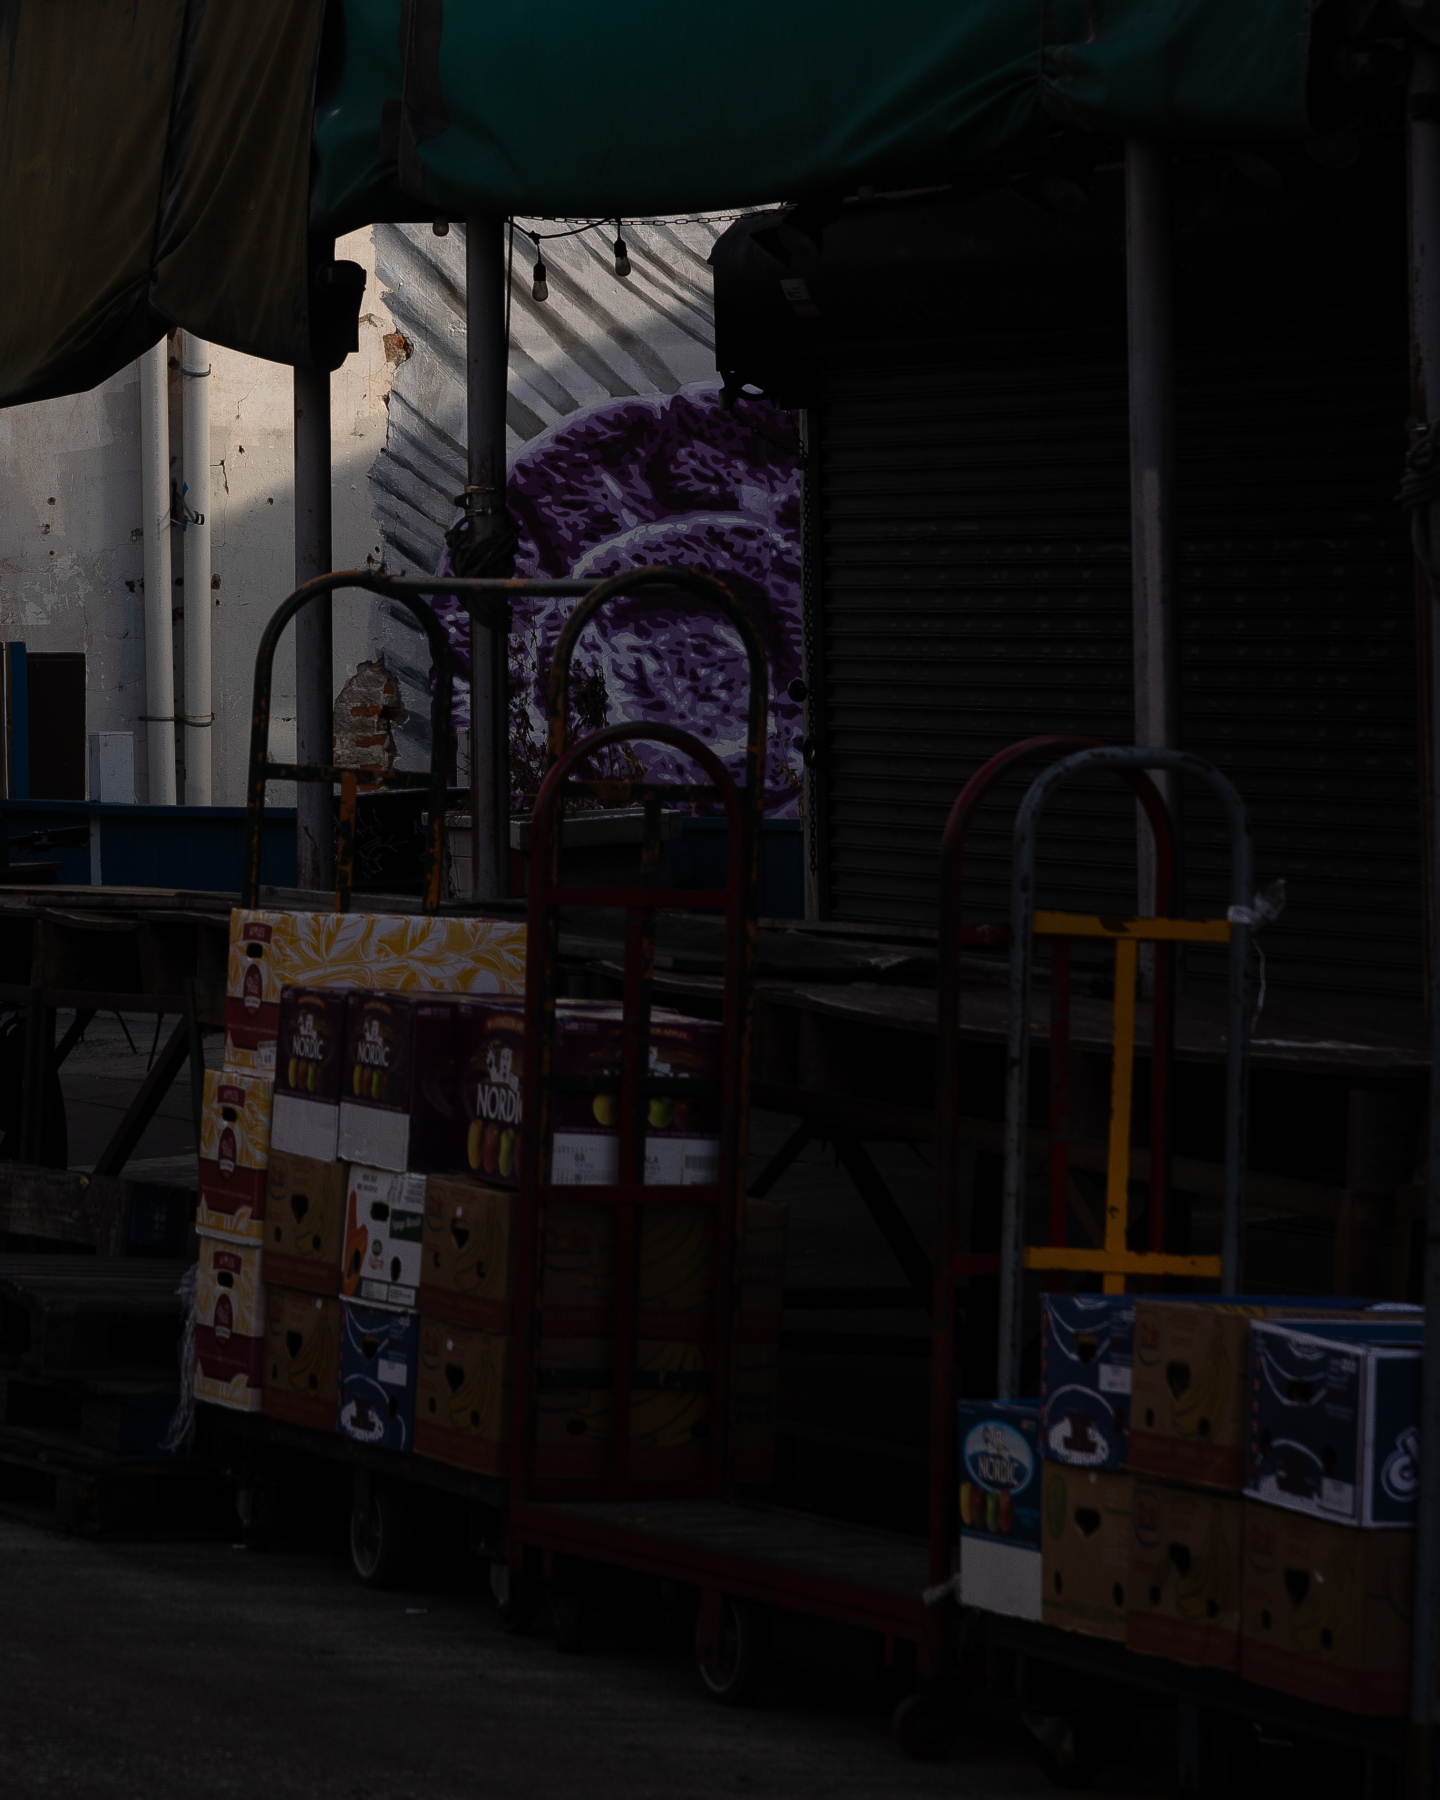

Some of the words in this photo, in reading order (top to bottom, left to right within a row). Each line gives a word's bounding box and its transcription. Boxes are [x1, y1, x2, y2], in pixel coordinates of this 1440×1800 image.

[292, 1036, 324, 1060] NORDIC
[357, 1041, 390, 1067] NORDIC
[476, 1082, 523, 1125] NORDI
[977, 1454, 1019, 1488] NORDIC
